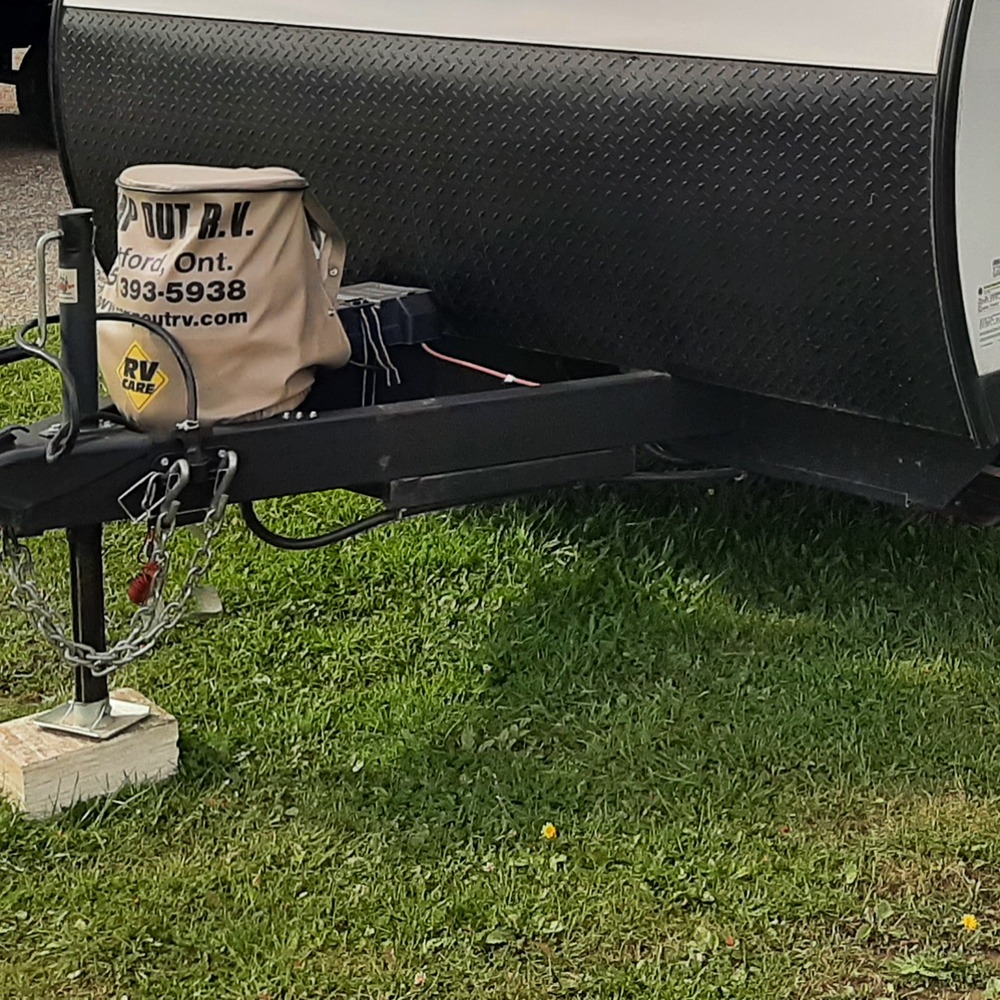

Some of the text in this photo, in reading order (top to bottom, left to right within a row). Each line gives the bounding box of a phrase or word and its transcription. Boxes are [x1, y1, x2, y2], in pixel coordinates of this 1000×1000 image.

[198, 201, 254, 240] R.V.
[174, 252, 233, 273] Ont.
[120, 277, 247, 303] 393-5938
[123, 357, 159, 380] RV
[122, 378, 156, 395] CARE
